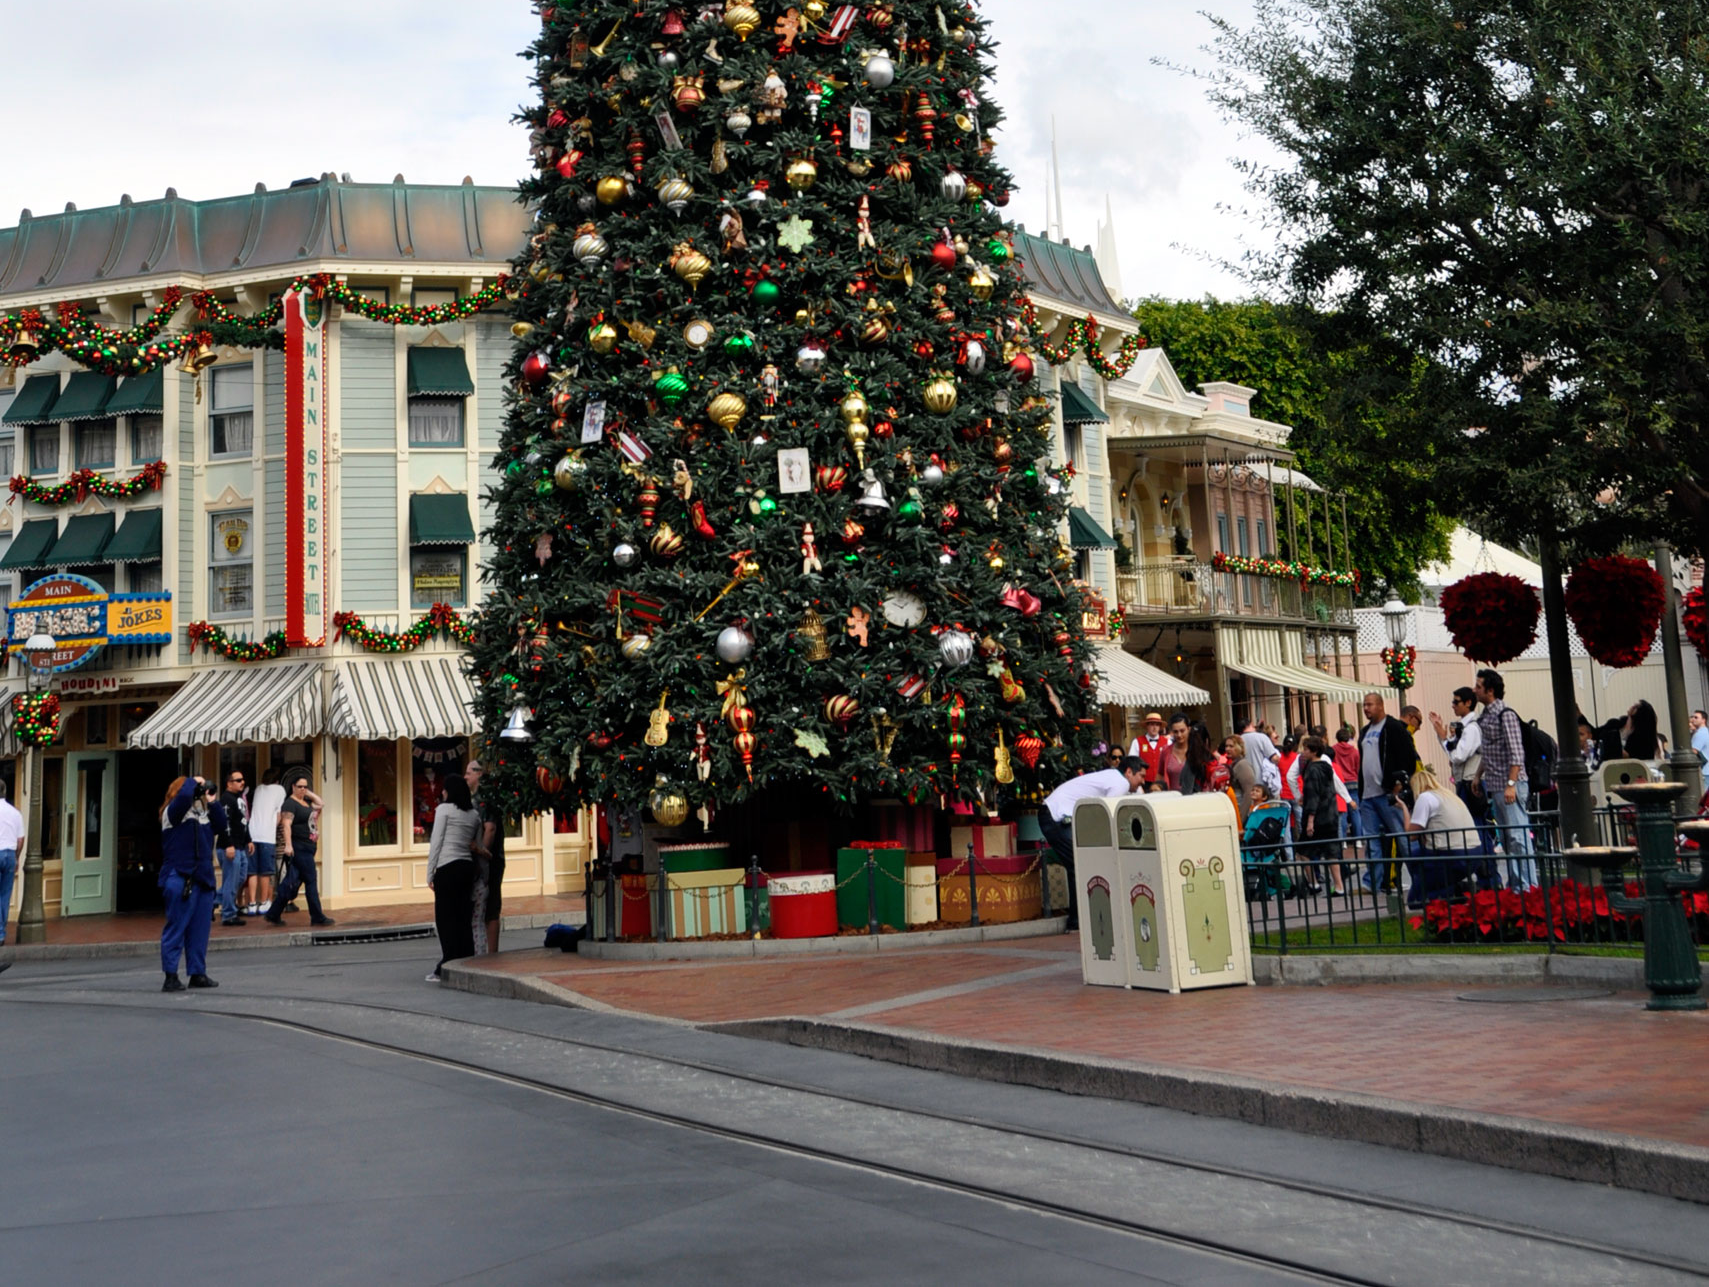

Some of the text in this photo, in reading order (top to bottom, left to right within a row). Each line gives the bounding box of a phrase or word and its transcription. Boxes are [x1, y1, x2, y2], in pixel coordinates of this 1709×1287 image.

[306, 341, 318, 580] MAIN STREET
[45, 585, 72, 596] MAIN
[117, 608, 162, 629] JOKES
[61, 677, 116, 691] HOUDINI
